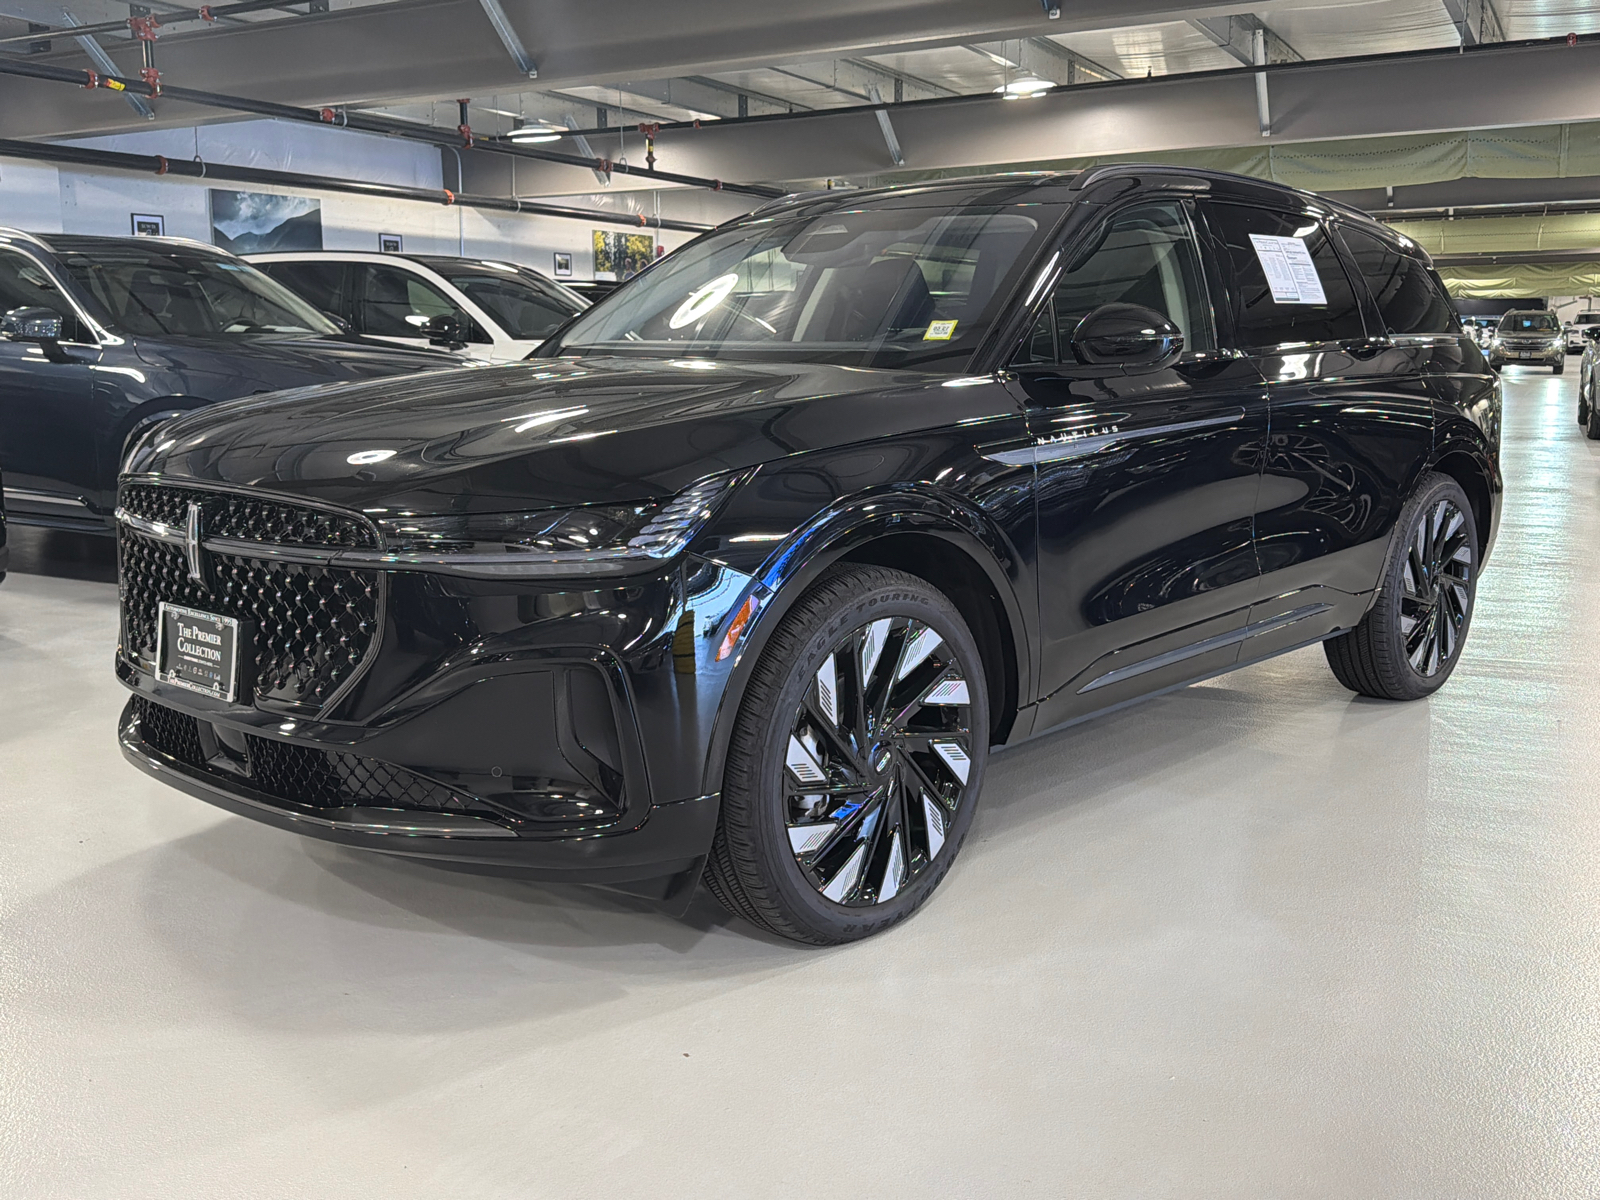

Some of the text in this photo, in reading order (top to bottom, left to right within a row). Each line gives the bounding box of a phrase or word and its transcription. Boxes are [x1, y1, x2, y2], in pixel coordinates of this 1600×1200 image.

[1036, 425, 1118, 445] NAUTILUS
[177, 622, 221, 646] THE PREMIER
[798, 593, 929, 681] EAGLE TOURING
[177, 637, 221, 661] COLLECTION
